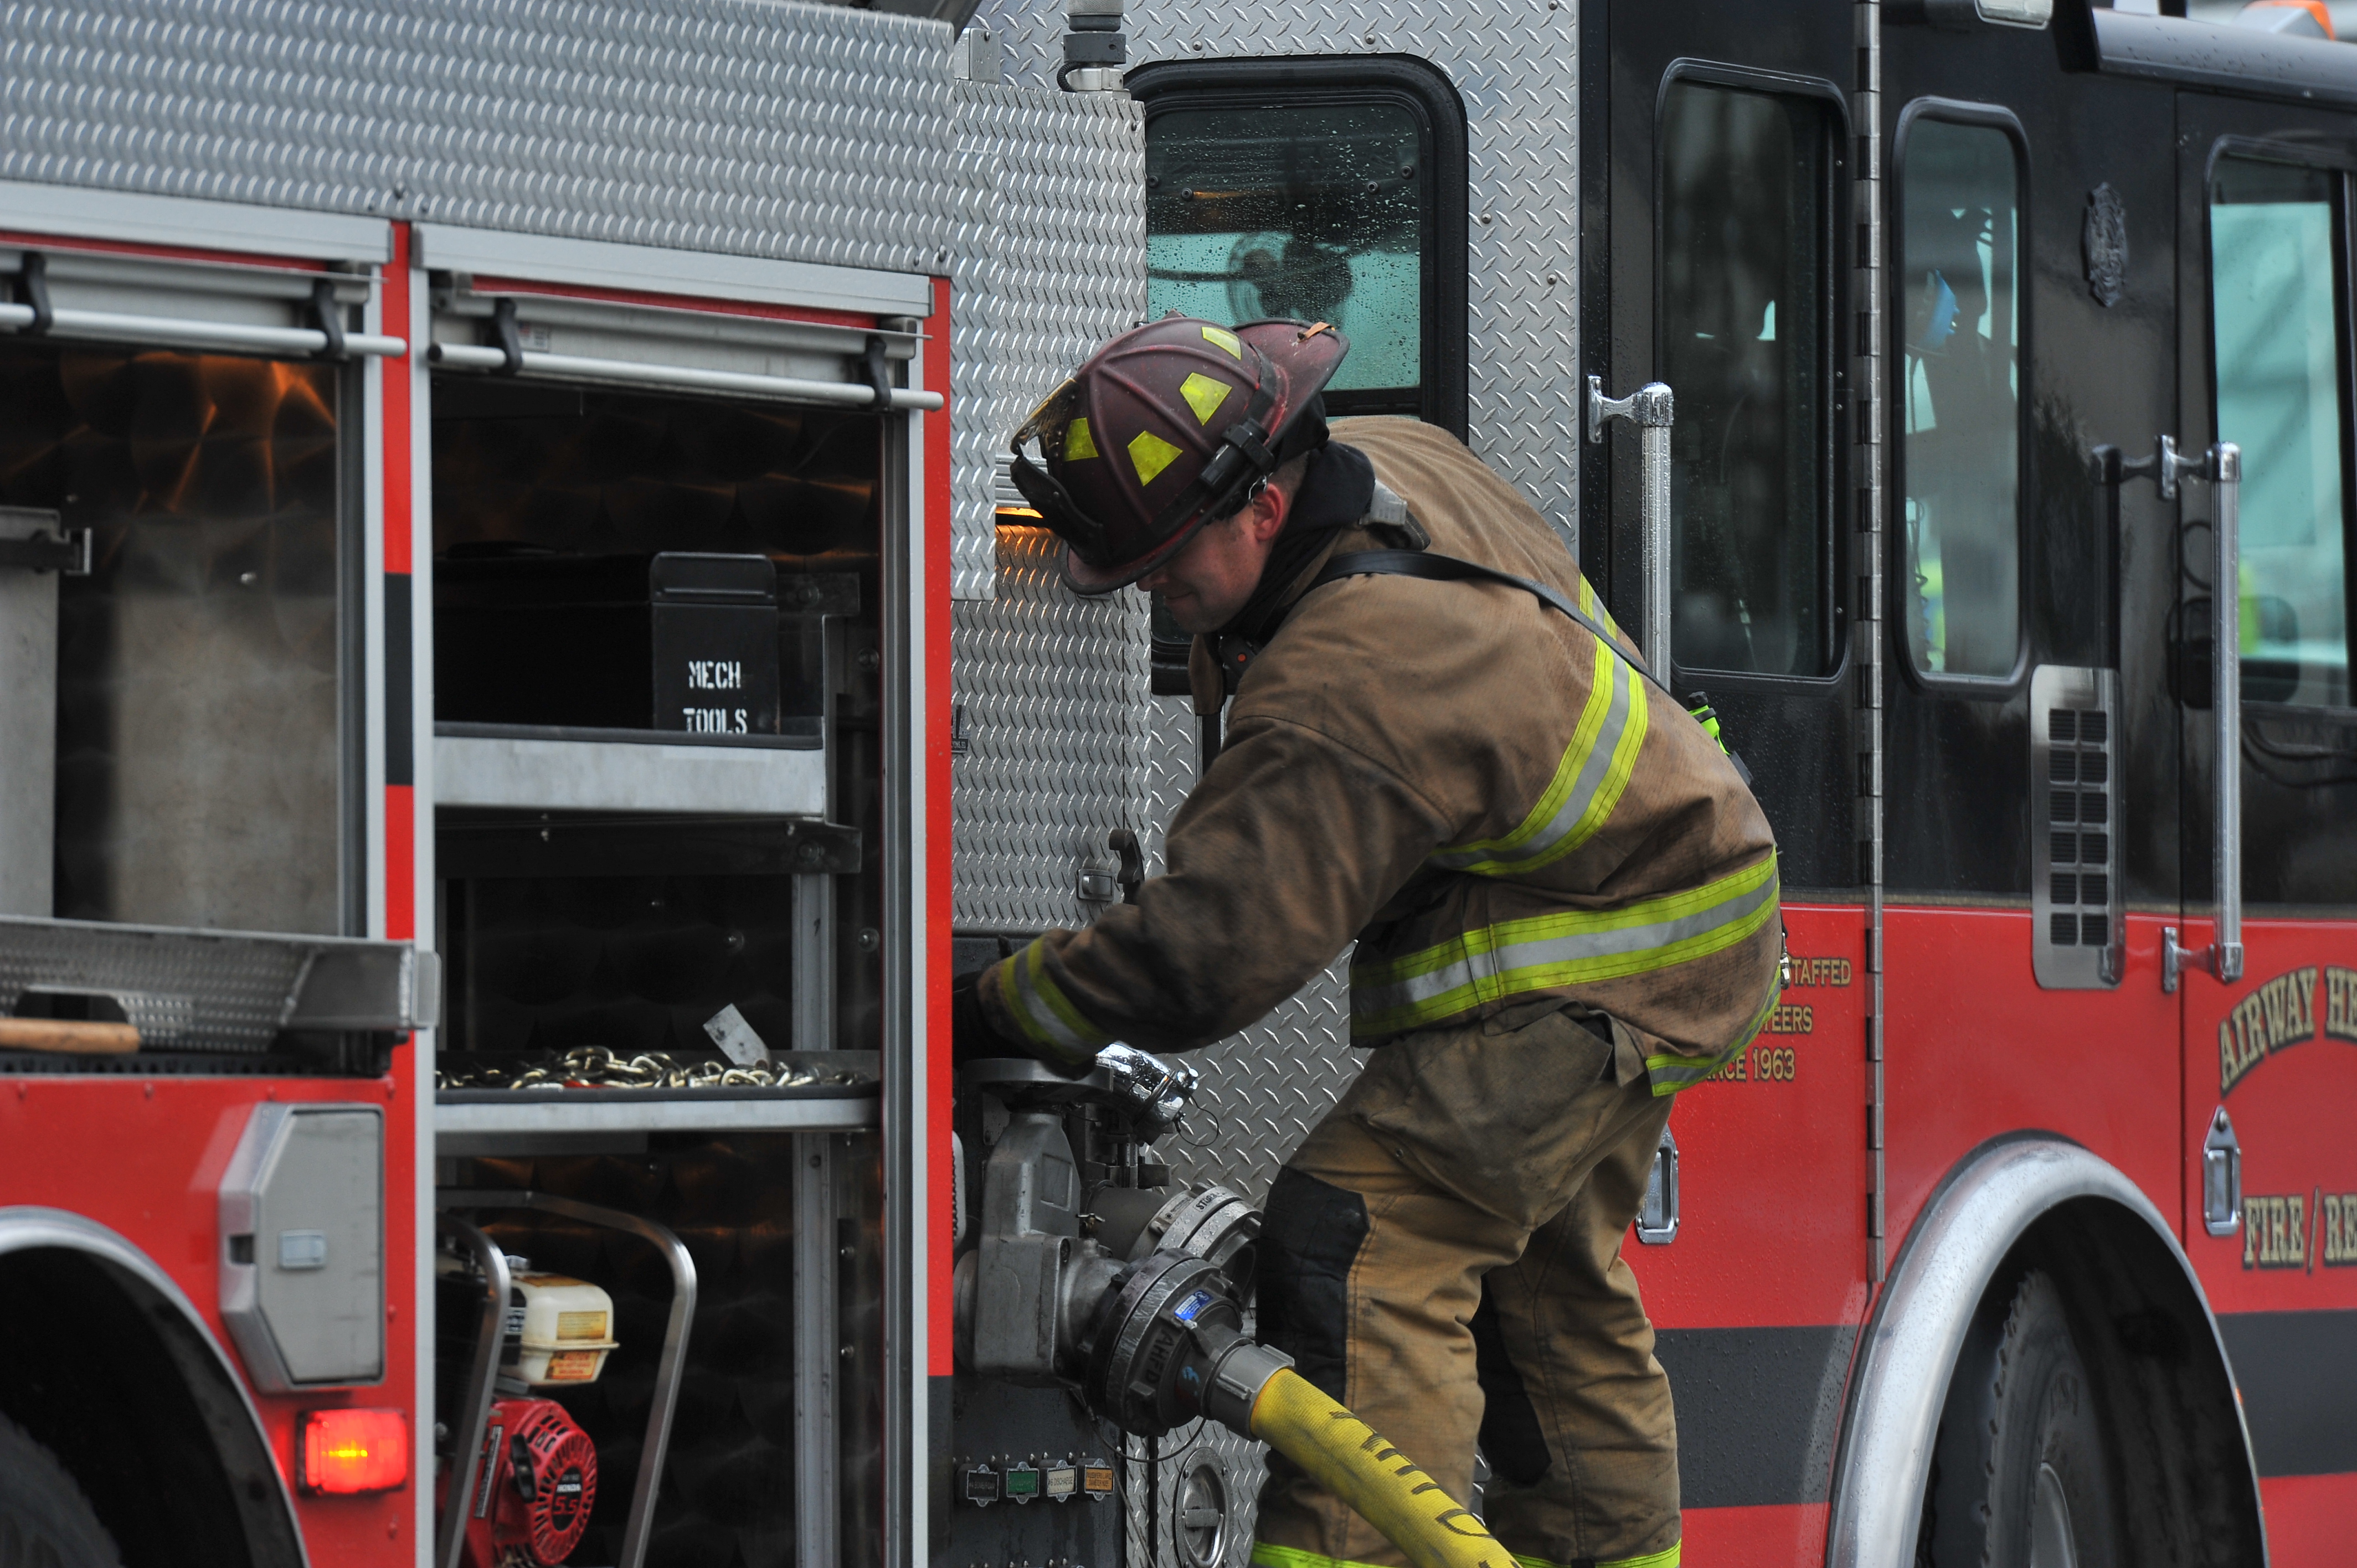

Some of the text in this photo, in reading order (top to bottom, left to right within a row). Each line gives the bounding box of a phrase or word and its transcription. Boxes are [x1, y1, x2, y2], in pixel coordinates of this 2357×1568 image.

[688, 661, 742, 689] MECH
[683, 708, 747, 735] TOOLS
[1787, 957, 1851, 986] TAFFED
[2219, 967, 2318, 1097] AIRWAY
[1752, 1048, 1795, 1080] 1963
